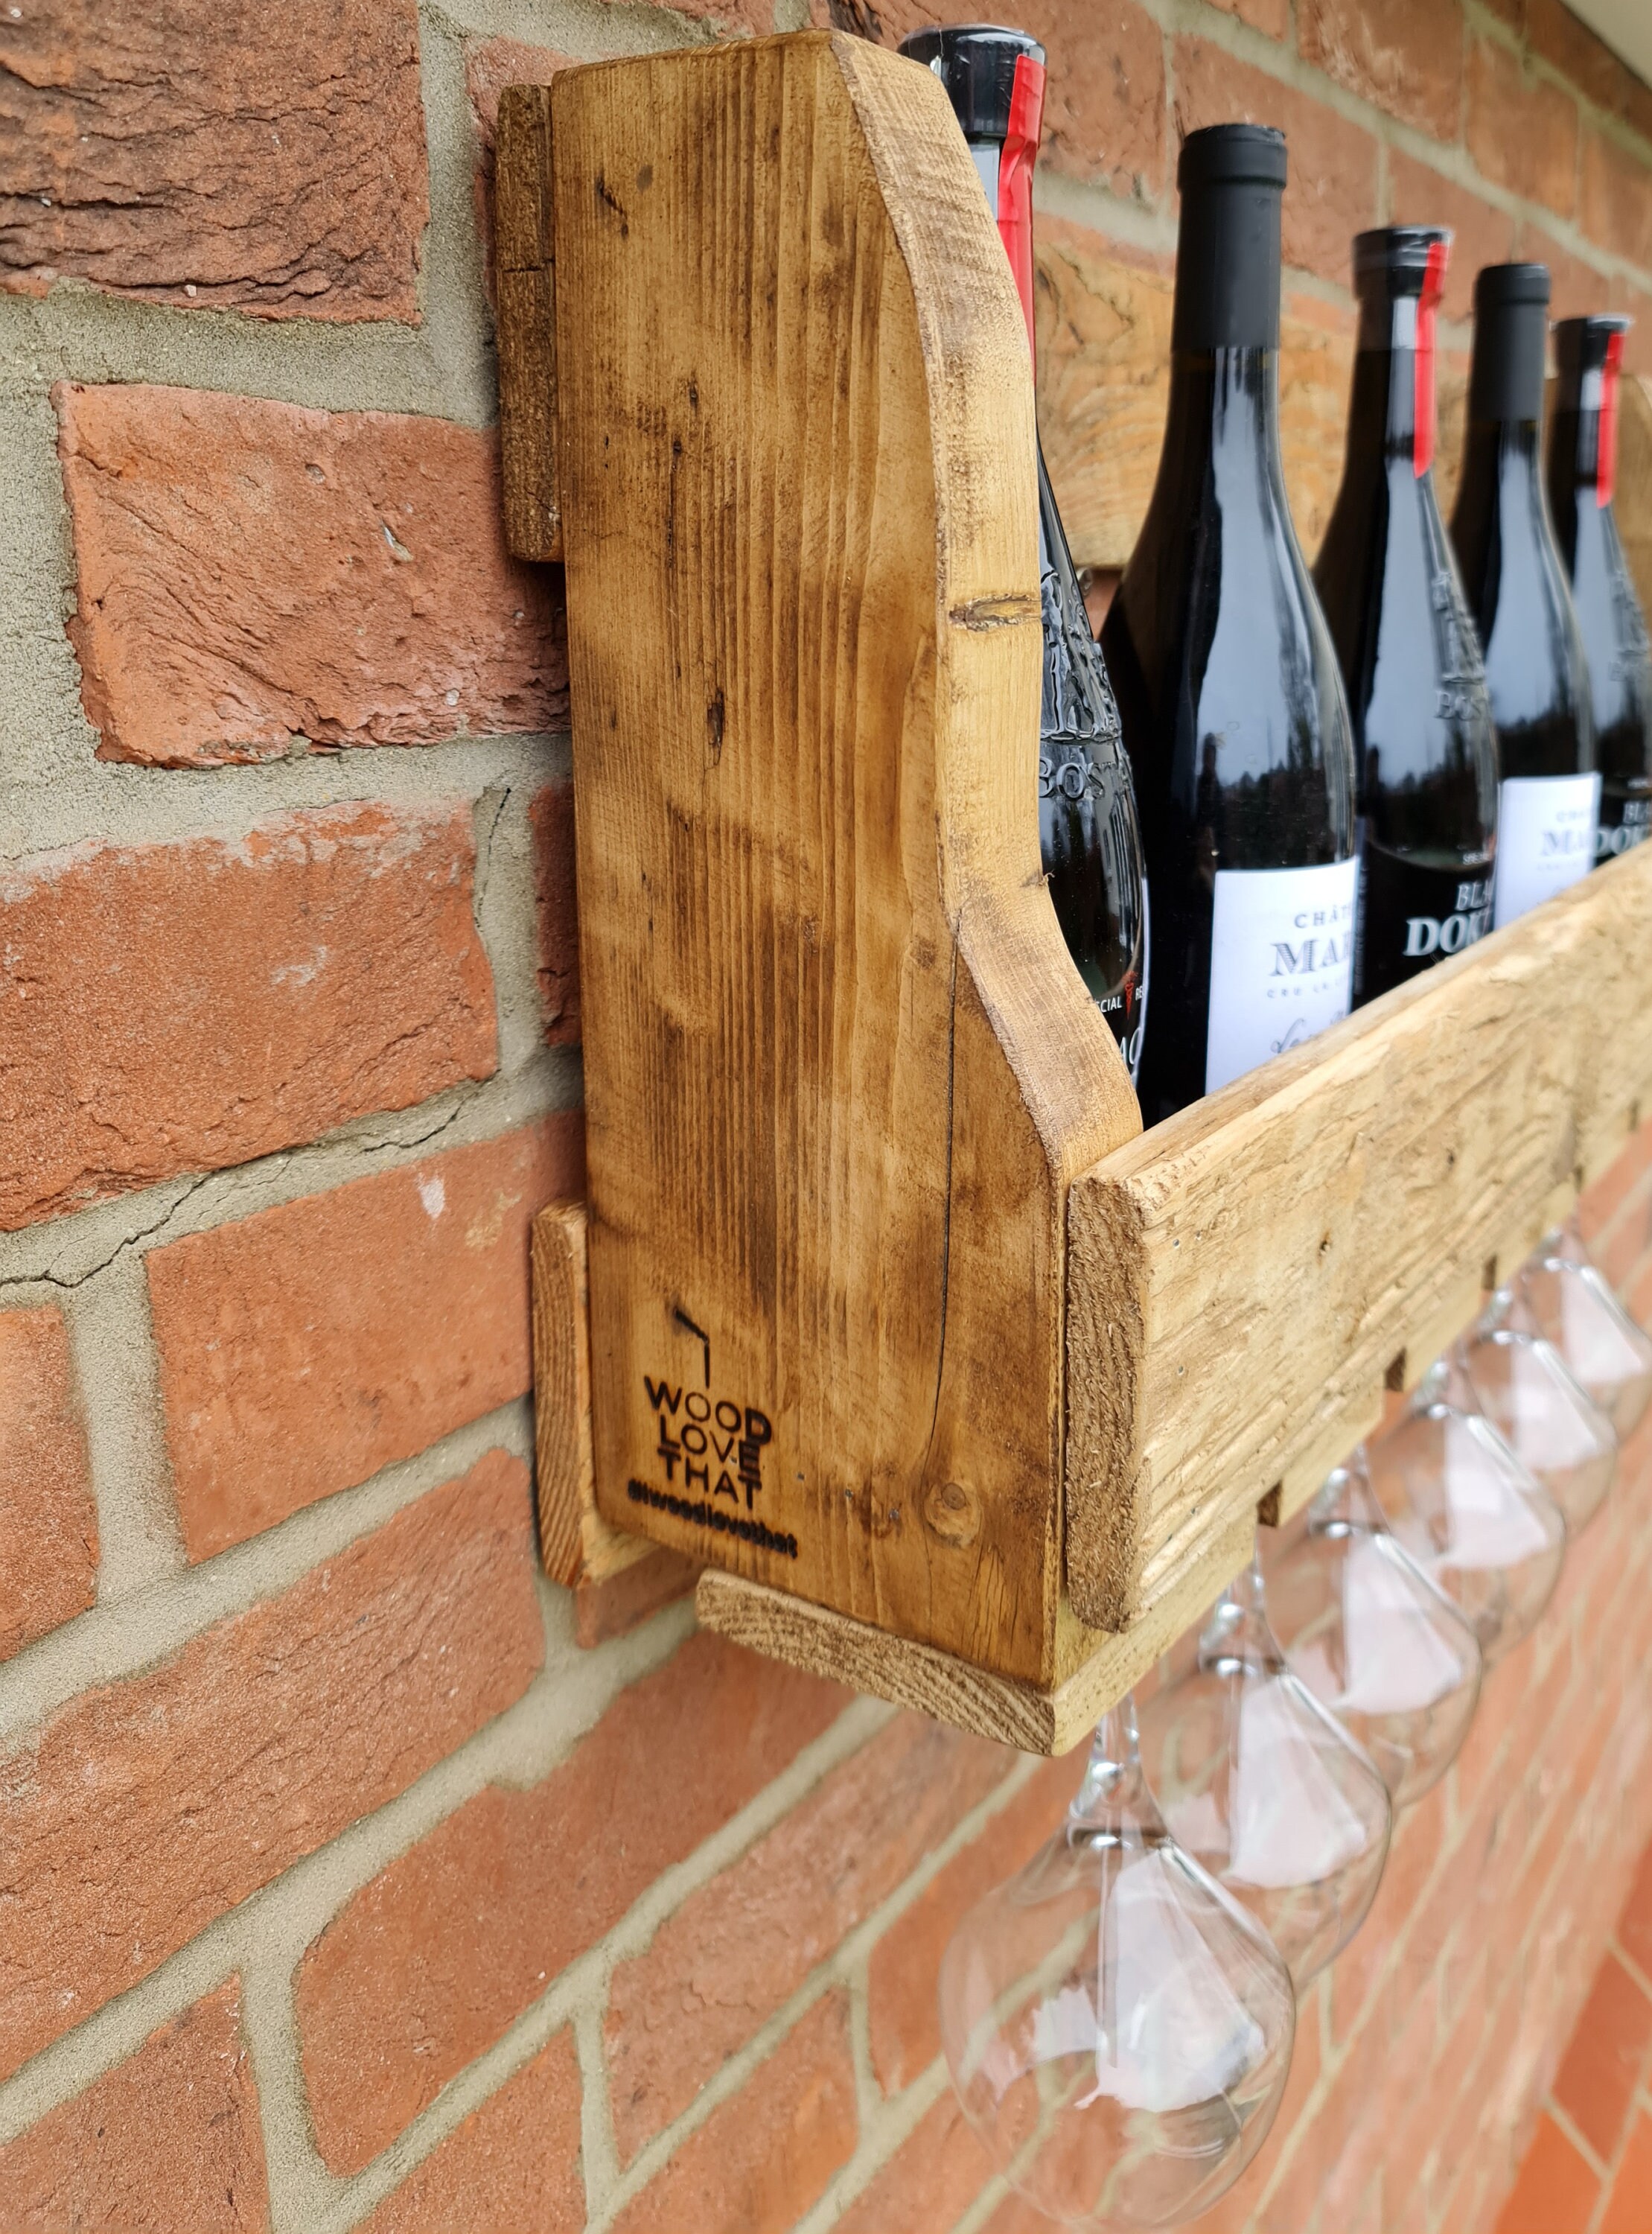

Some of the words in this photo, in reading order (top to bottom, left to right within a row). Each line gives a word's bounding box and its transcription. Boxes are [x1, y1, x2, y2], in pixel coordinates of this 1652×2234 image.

[644, 1375, 772, 1445] WOOD
[657, 1414, 761, 1473] LOVE
[657, 1449, 762, 1510] THAT
